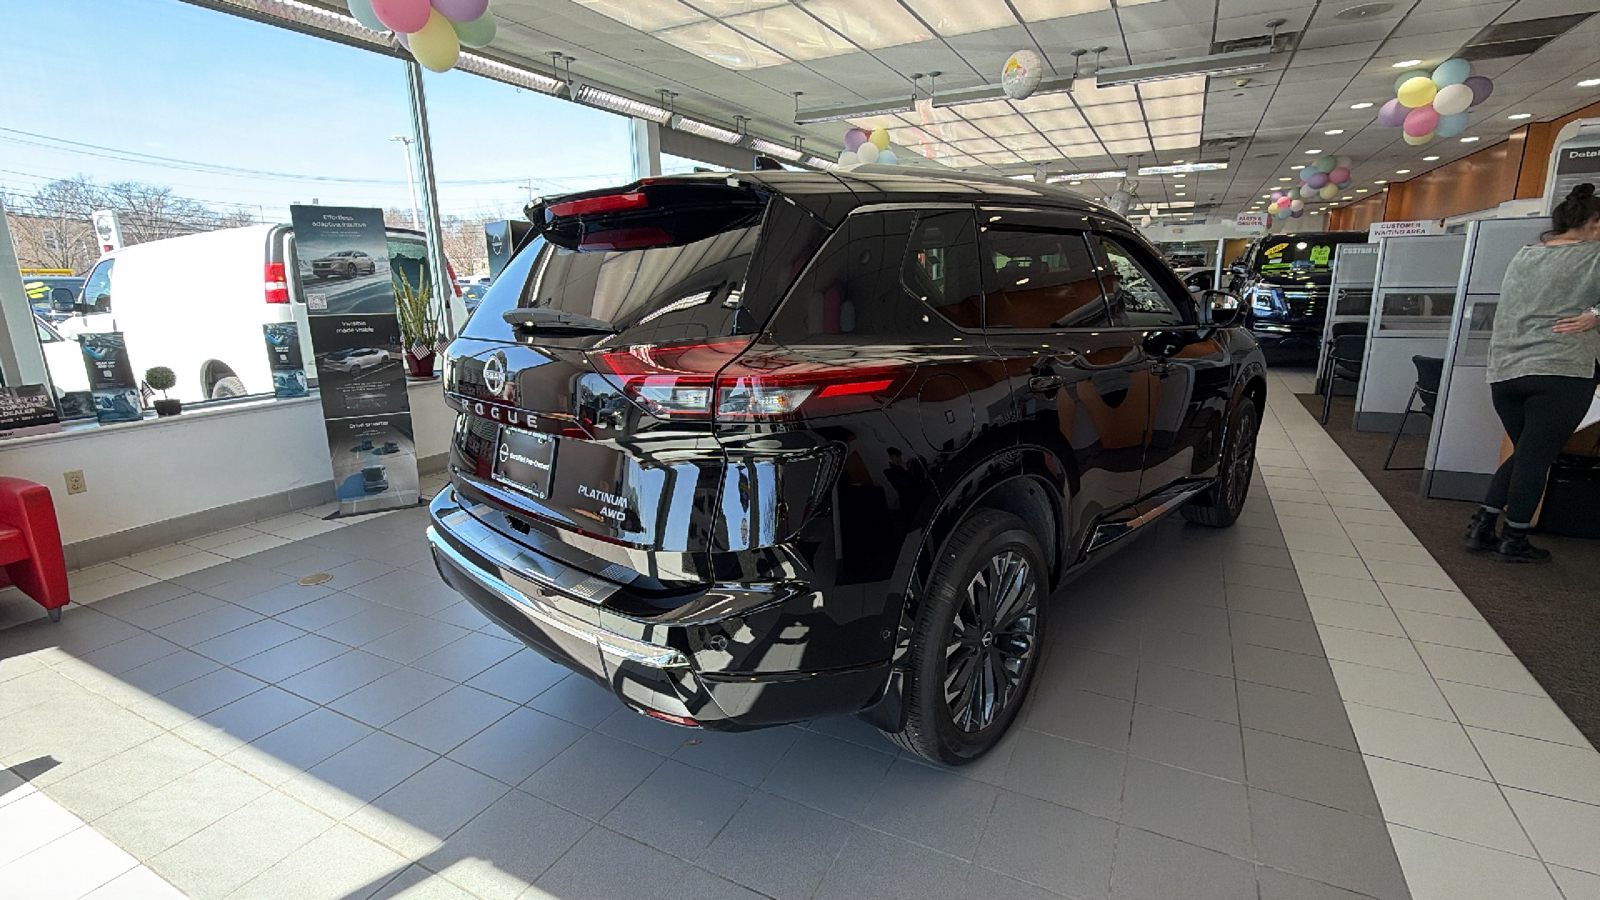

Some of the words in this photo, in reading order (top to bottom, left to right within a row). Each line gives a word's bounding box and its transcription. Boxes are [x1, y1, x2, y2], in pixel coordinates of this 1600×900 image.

[461, 398, 538, 429] ROGUE
[577, 484, 628, 509] PLATINUM
[599, 506, 626, 521] AWD
